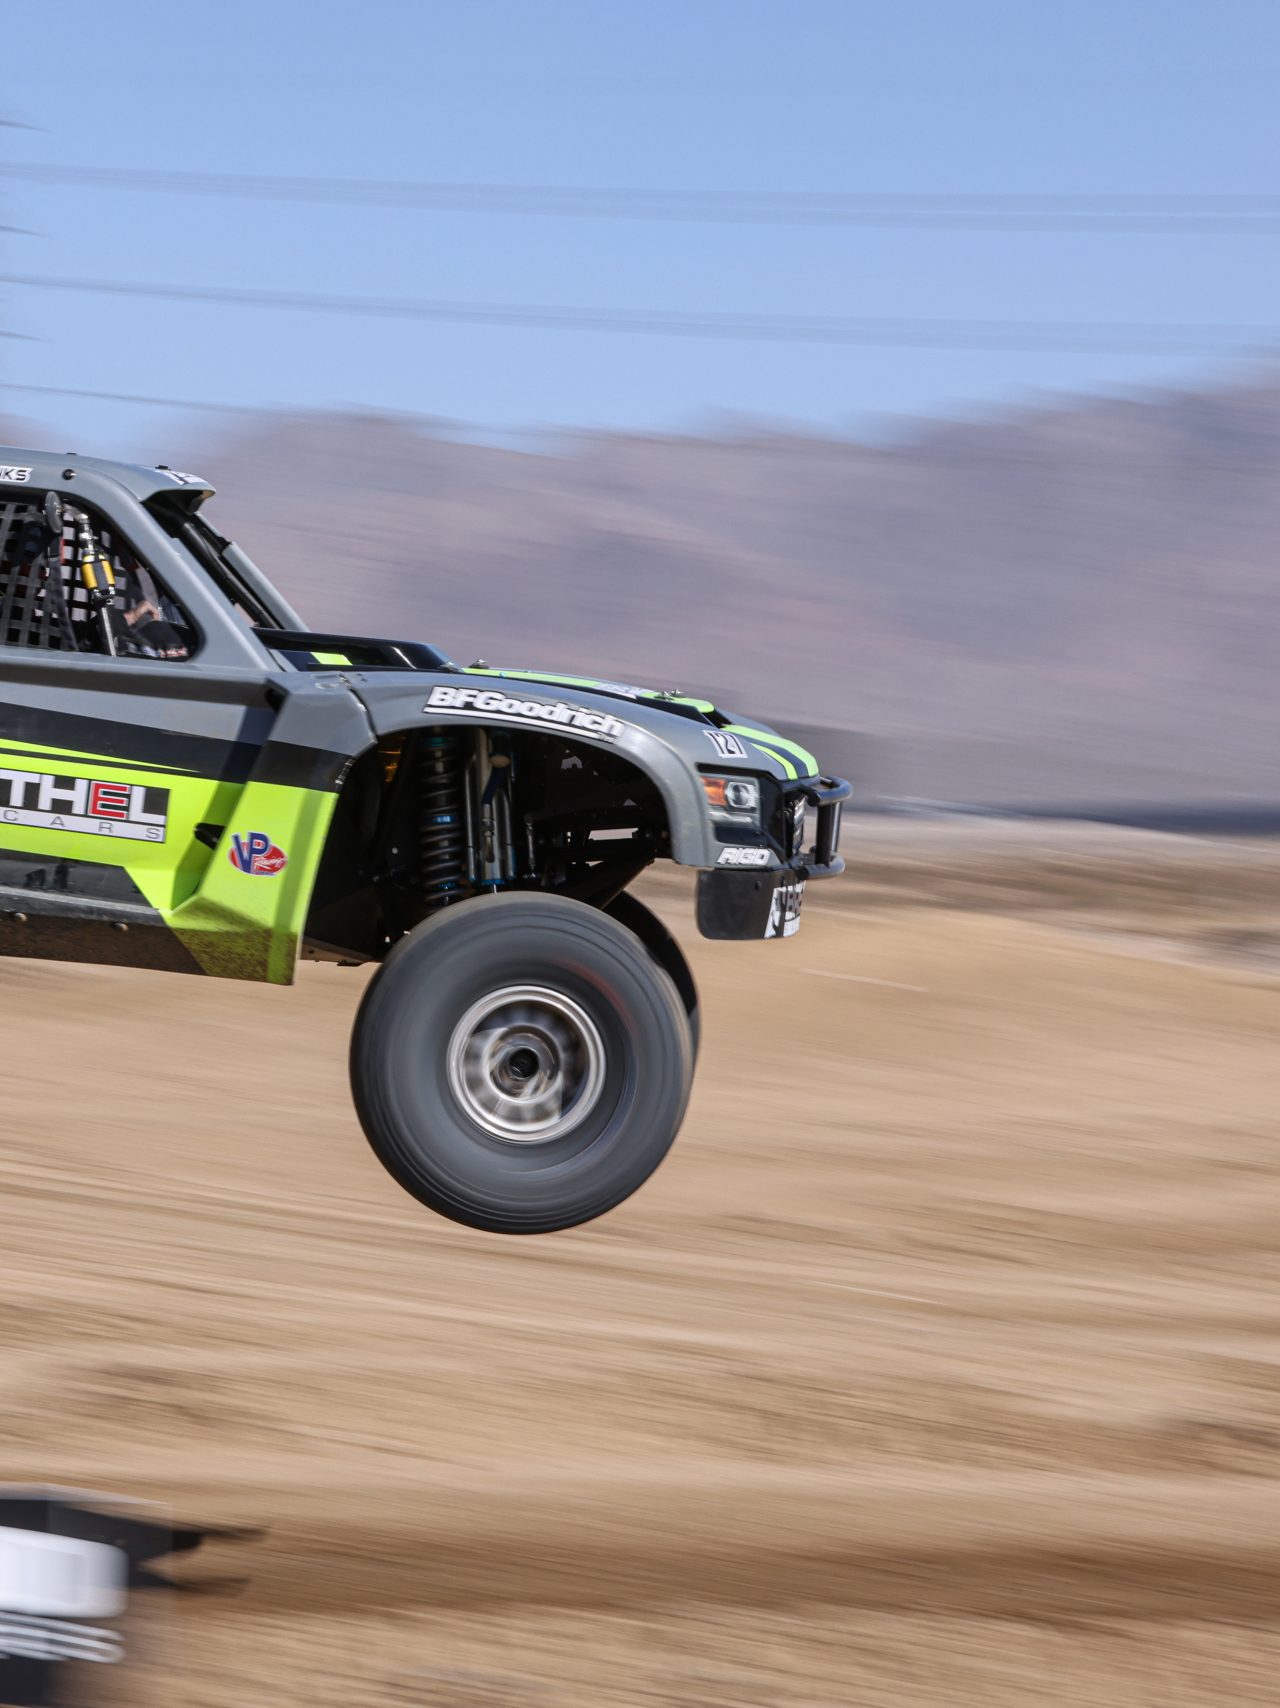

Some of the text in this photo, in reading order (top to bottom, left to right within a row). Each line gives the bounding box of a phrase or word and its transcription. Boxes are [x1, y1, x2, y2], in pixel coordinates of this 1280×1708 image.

[427, 685, 625, 737] BFGoodrich
[705, 730, 746, 757] 127
[231, 832, 269, 874] VP
